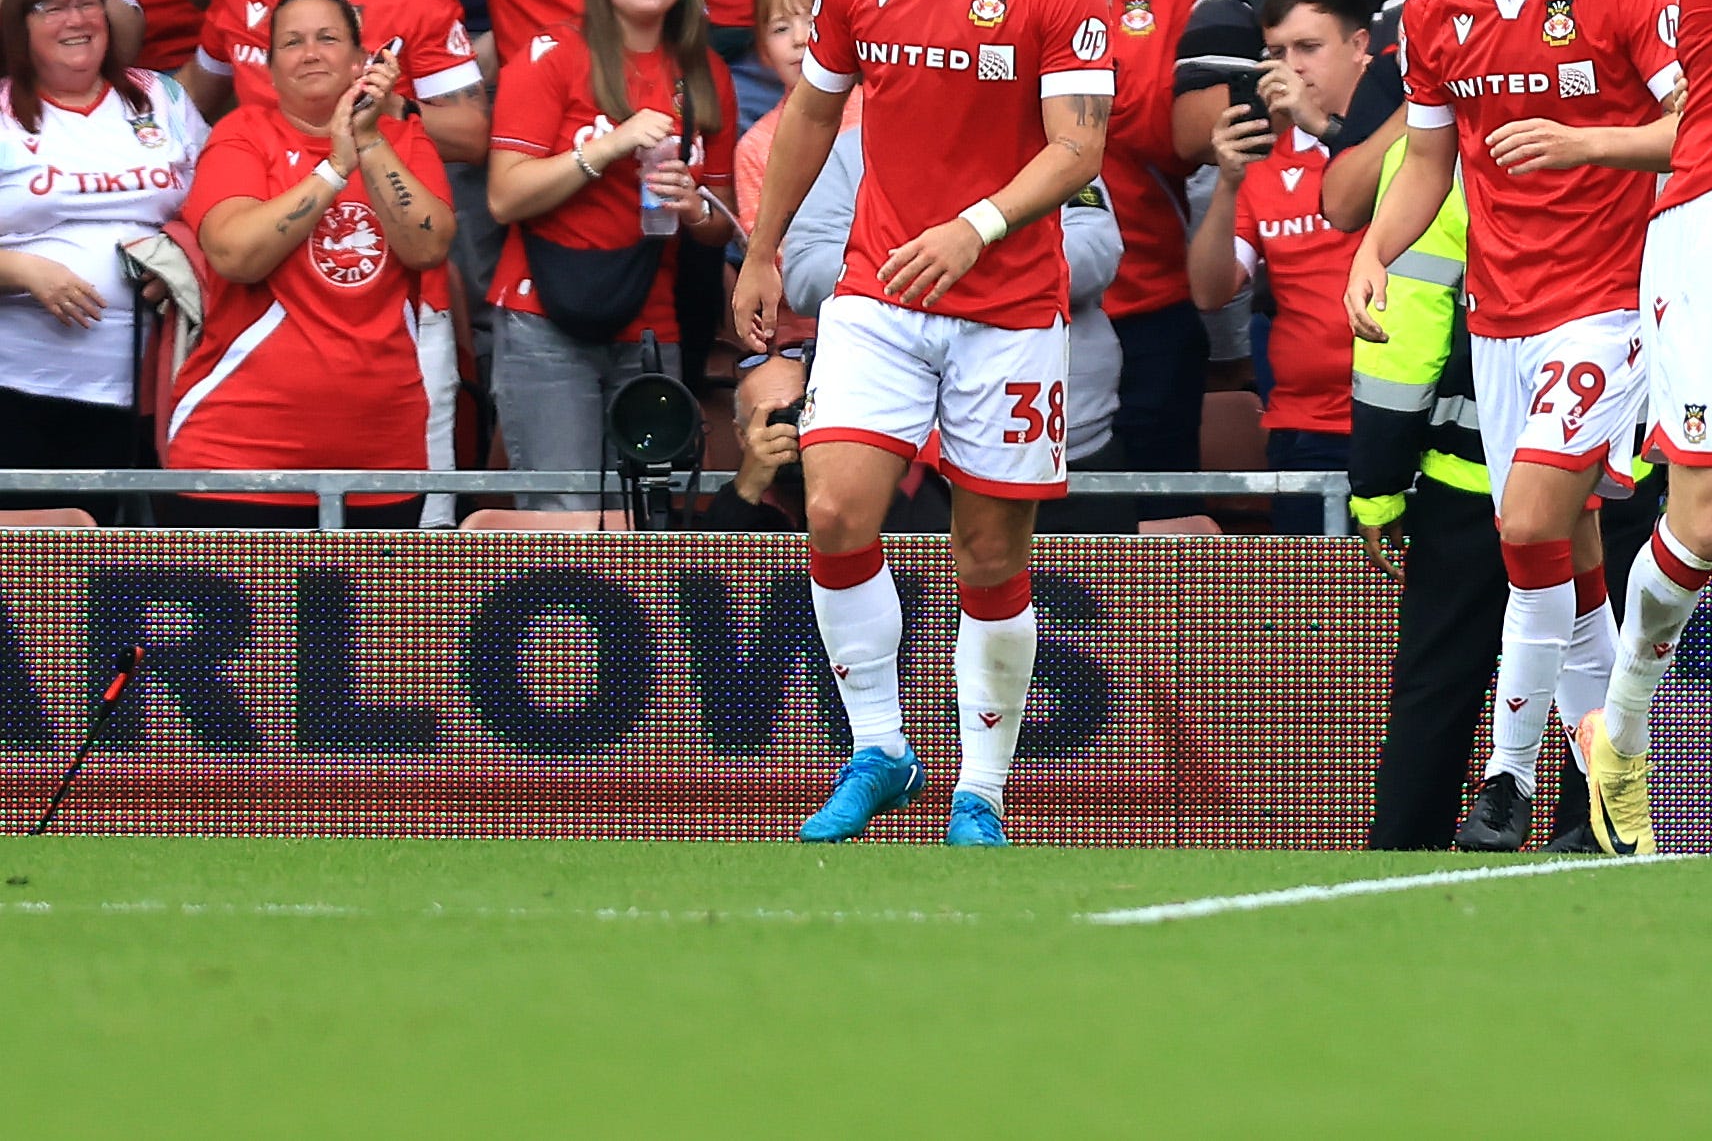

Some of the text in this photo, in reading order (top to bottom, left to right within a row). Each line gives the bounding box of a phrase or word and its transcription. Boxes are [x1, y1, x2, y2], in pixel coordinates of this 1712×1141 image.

[856, 39, 970, 71] UNITED
[1073, 18, 1107, 61] hp
[1003, 381, 1065, 444] 38
[1533, 360, 1605, 419] 29
[0, 563, 1111, 757] RLOWS
